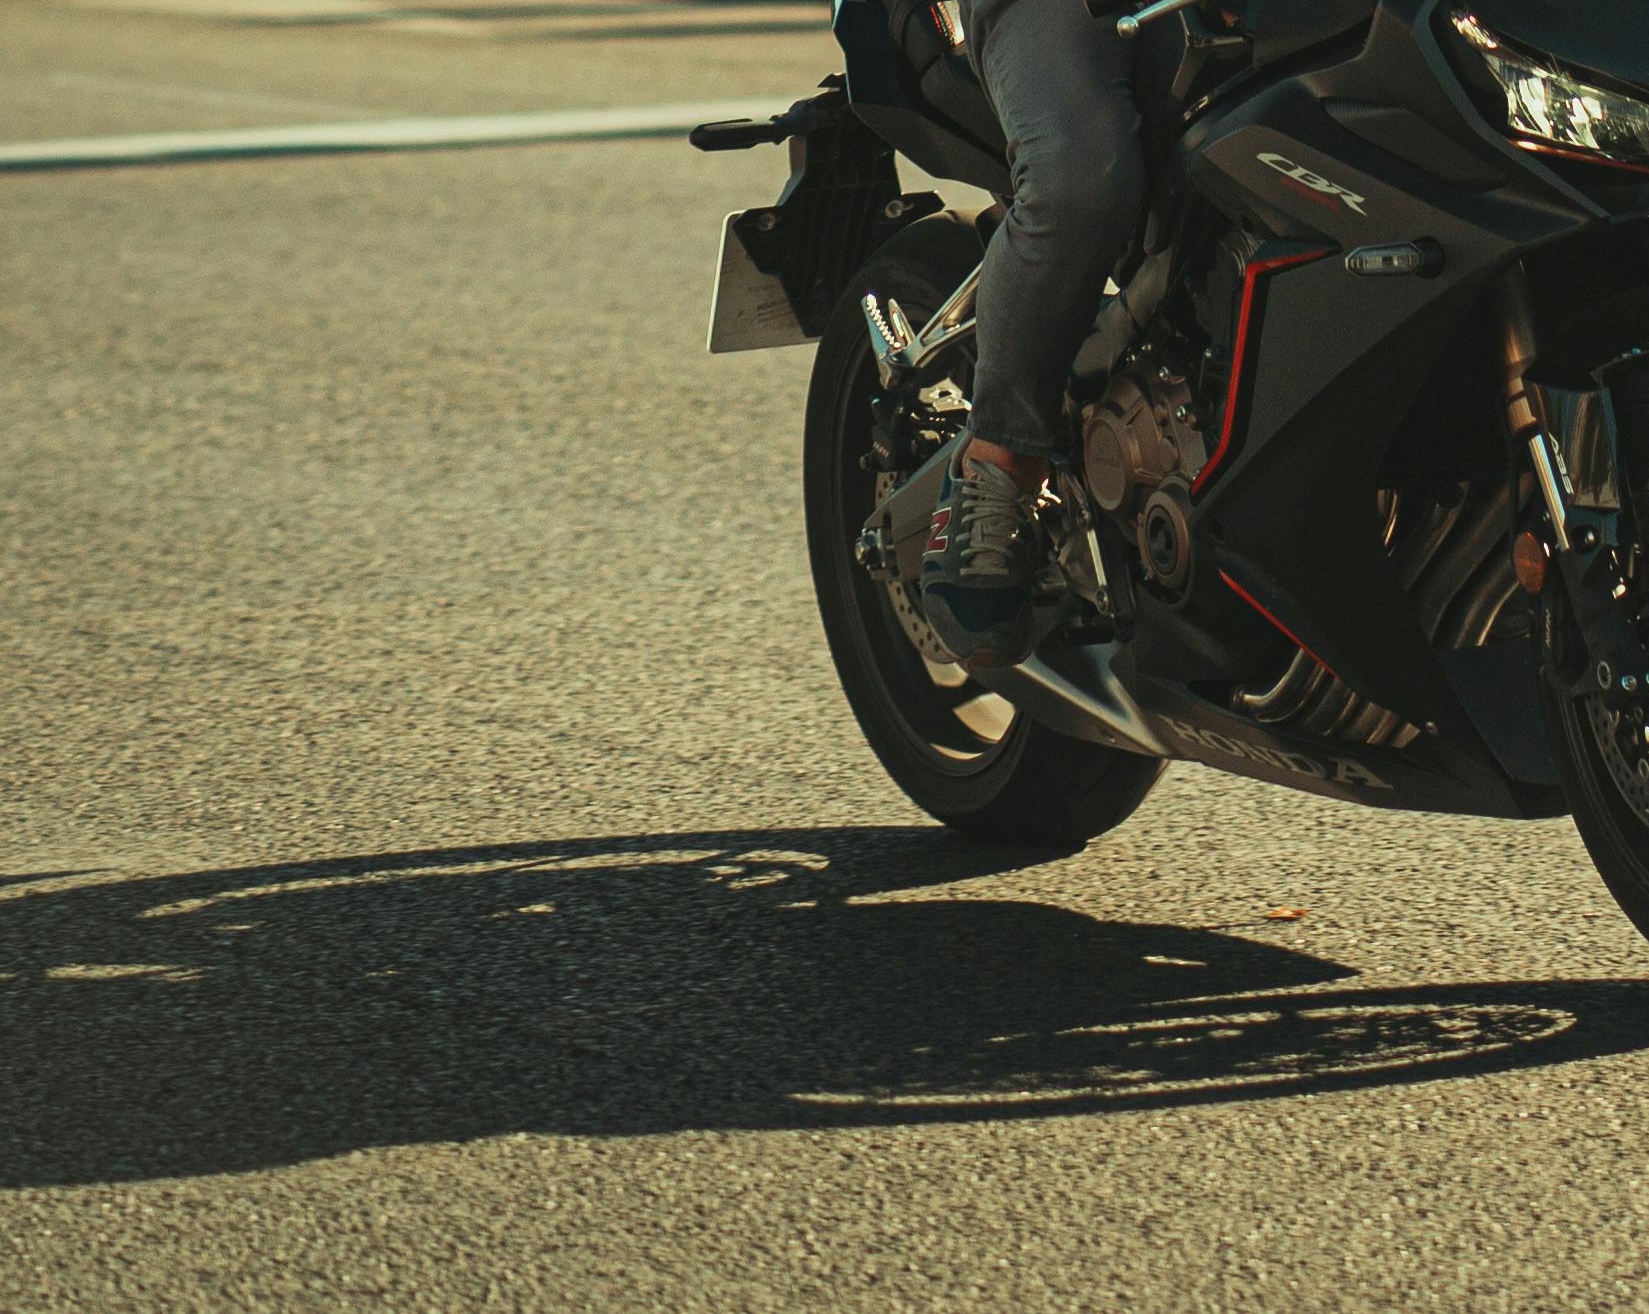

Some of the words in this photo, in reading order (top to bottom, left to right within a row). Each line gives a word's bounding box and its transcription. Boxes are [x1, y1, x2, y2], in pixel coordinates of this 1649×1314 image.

[1256, 152, 1368, 217] CBR
[1548, 431, 1575, 495] ABS
[1157, 714, 1394, 791] HONDA
